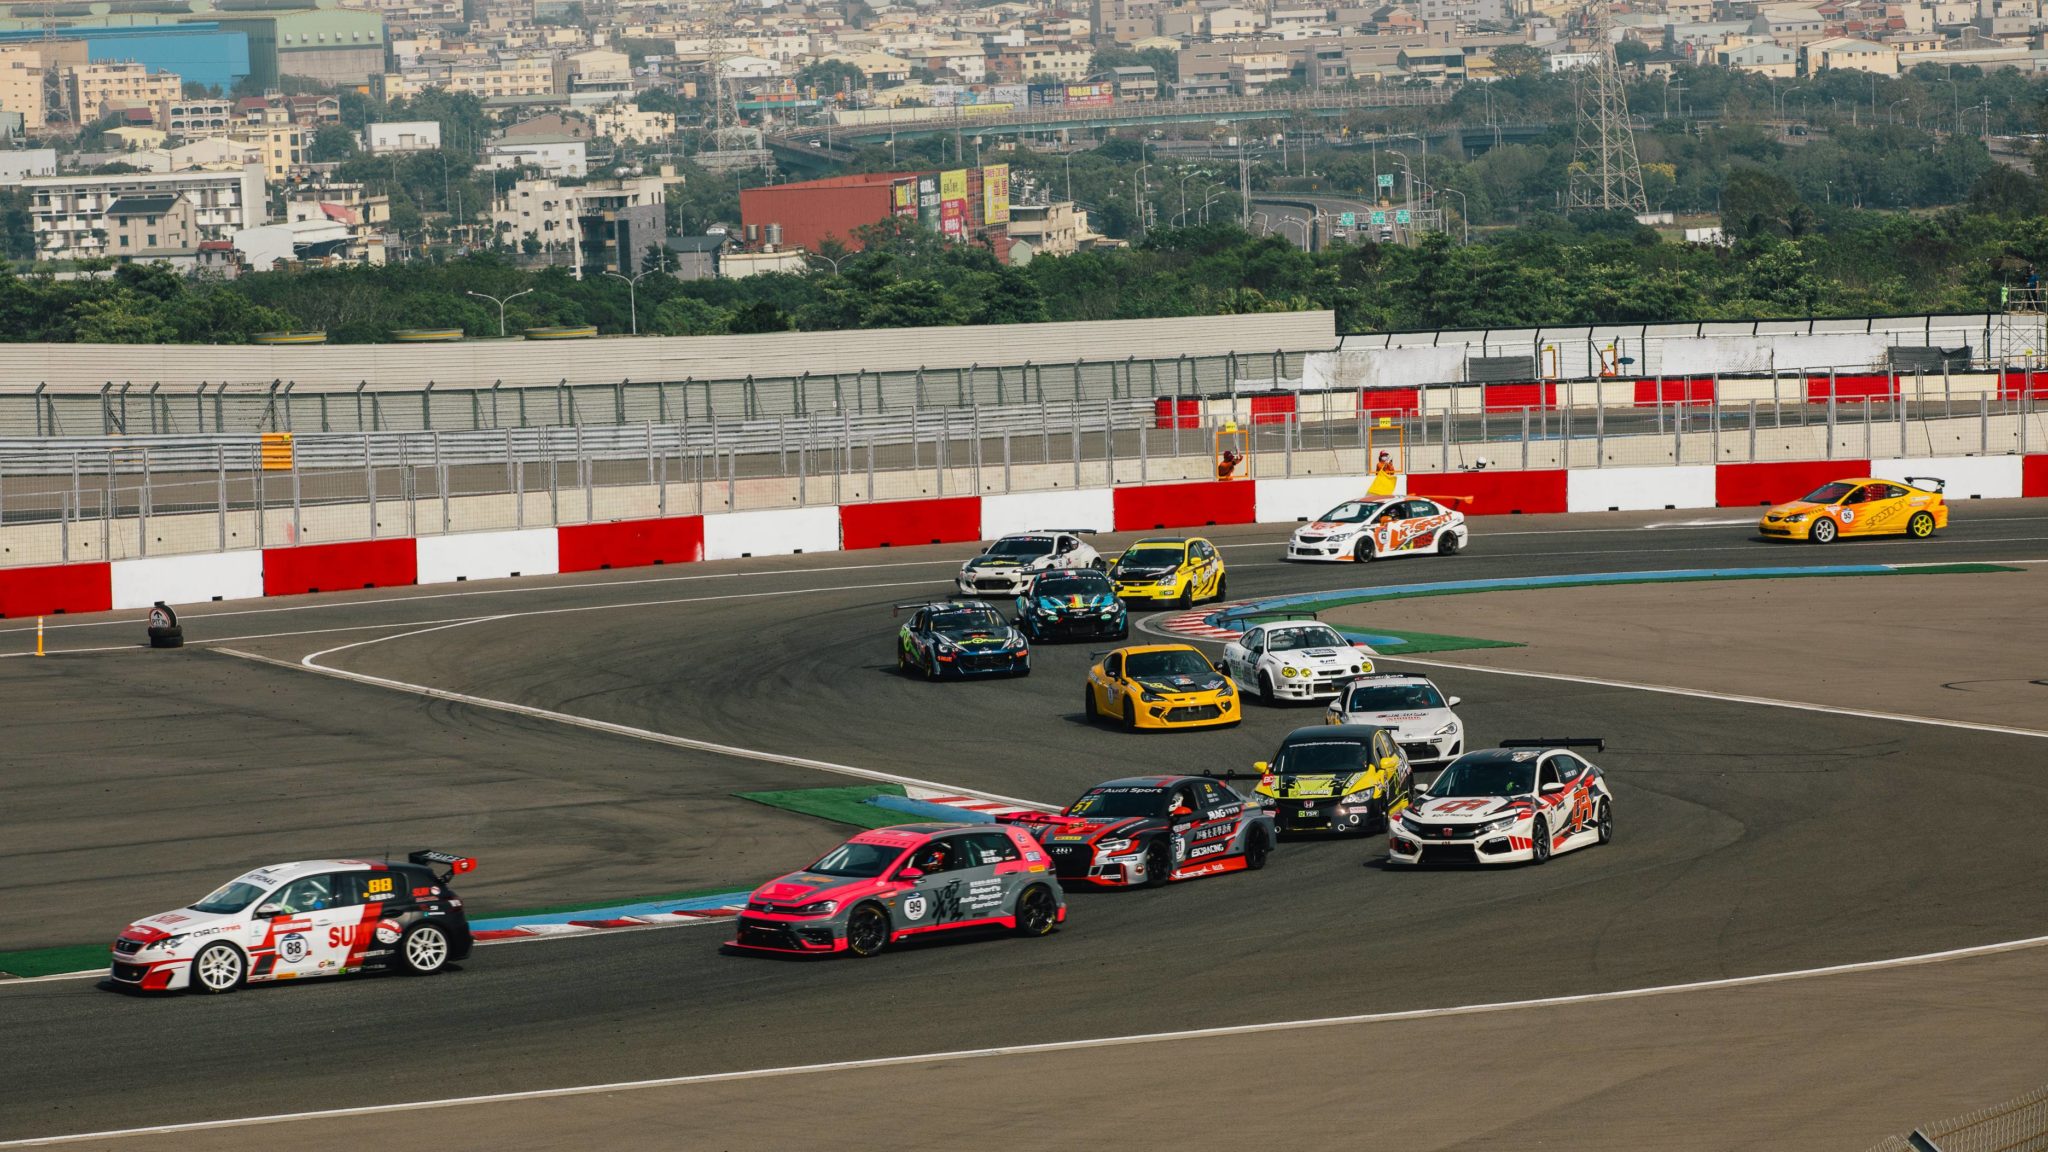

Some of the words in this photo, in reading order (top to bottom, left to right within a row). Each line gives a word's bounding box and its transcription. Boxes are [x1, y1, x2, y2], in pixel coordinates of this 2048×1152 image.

[1071, 800, 1094, 813] 51
[368, 877, 393, 893] 88
[909, 900, 922, 914] 99
[286, 941, 302, 955] 88
